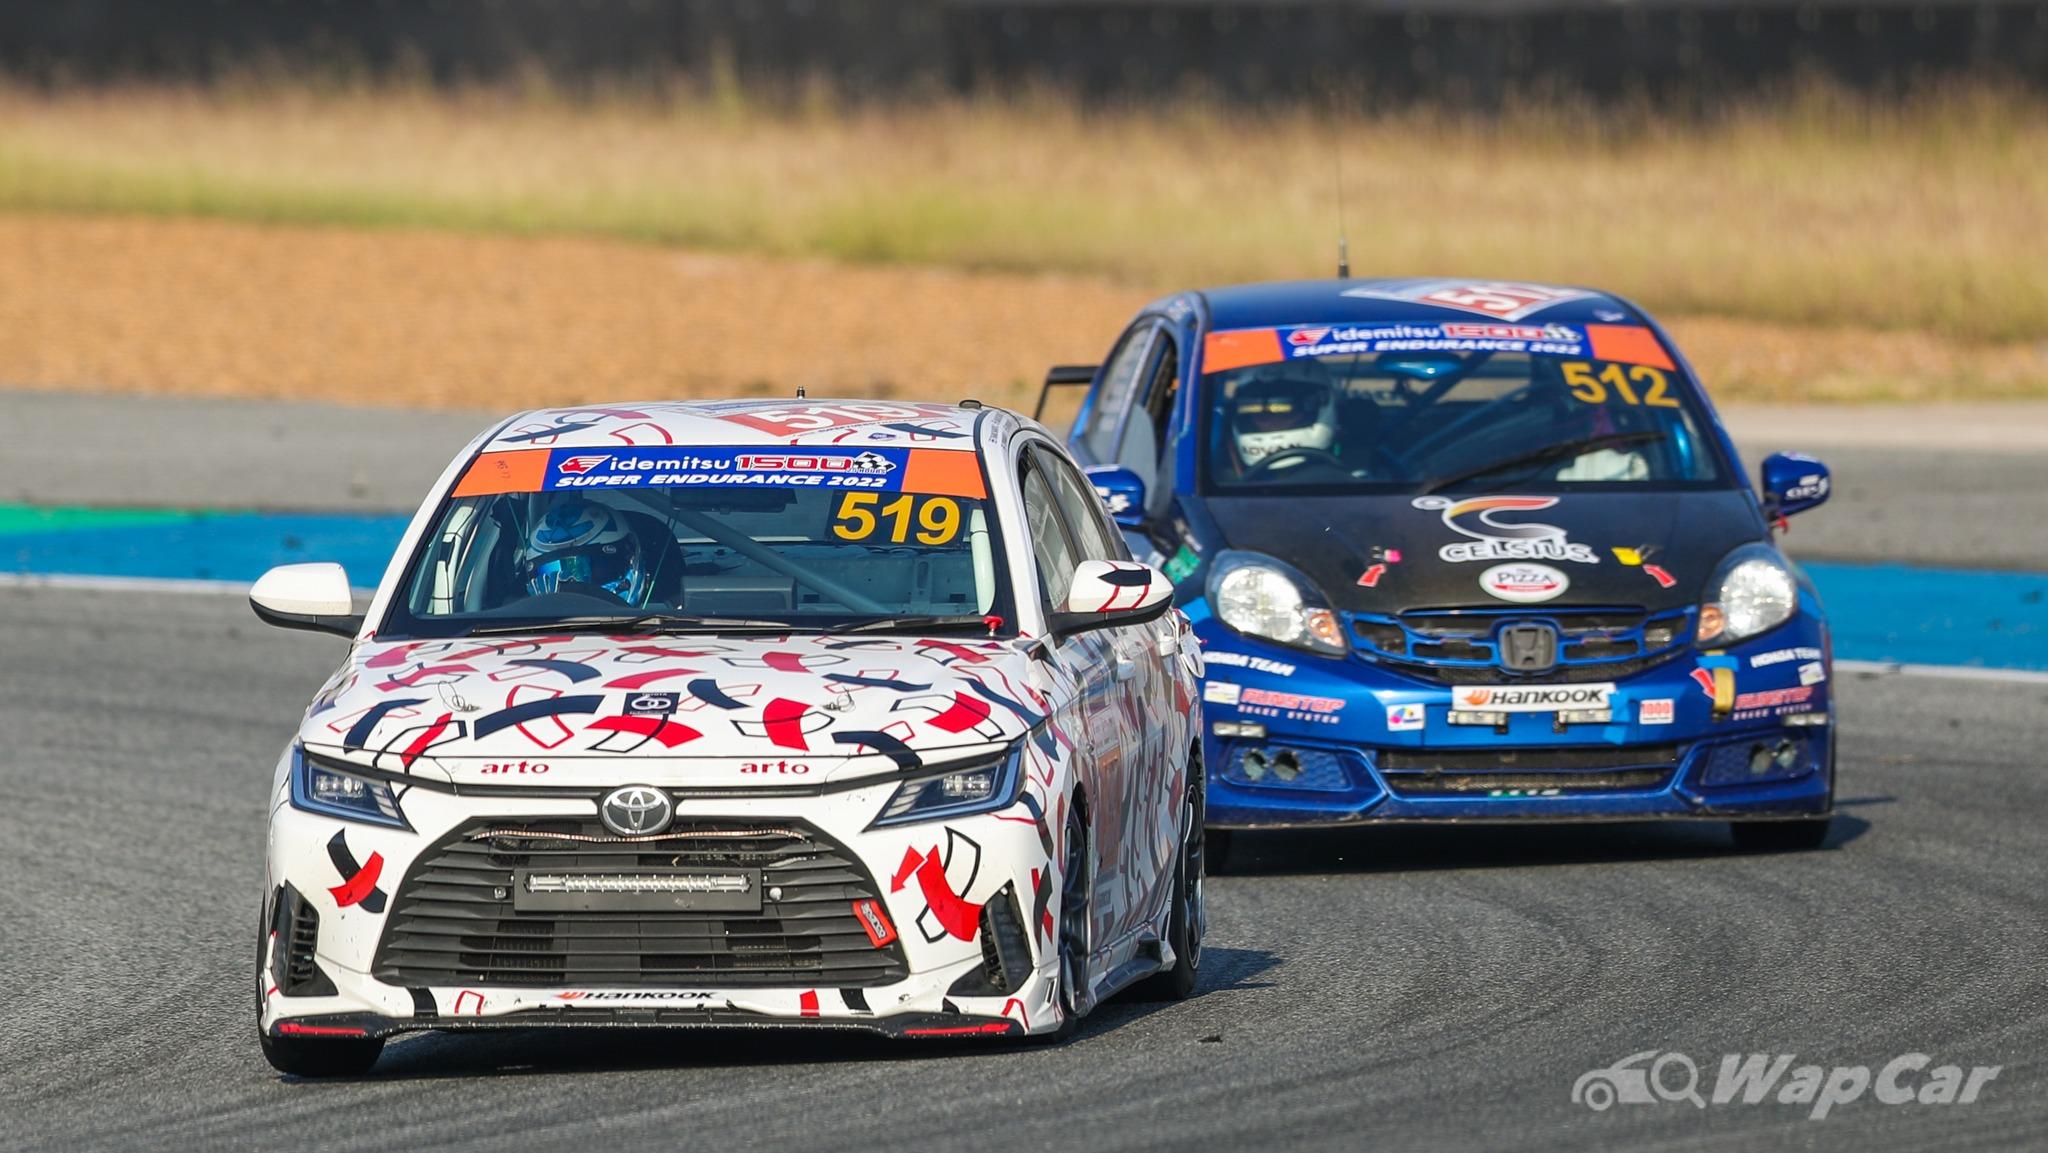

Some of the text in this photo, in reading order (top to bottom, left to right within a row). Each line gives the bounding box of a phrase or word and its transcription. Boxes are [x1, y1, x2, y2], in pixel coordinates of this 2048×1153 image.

[1332, 323, 1545, 341] idemitsu 1500
[1293, 340, 1581, 357] SUPER ENDURANCE 2022
[1560, 362, 1679, 408] 512
[748, 404, 921, 428] 519
[609, 455, 854, 474] idemitsu 1500
[555, 474, 888, 488] SUPER ENDURANCE 2022
[832, 491, 961, 545] 519
[1440, 540, 1600, 564] CELSIUS
[1249, 656, 1297, 677] TEAM
[480, 760, 550, 775] arto
[740, 760, 811, 775] arto
